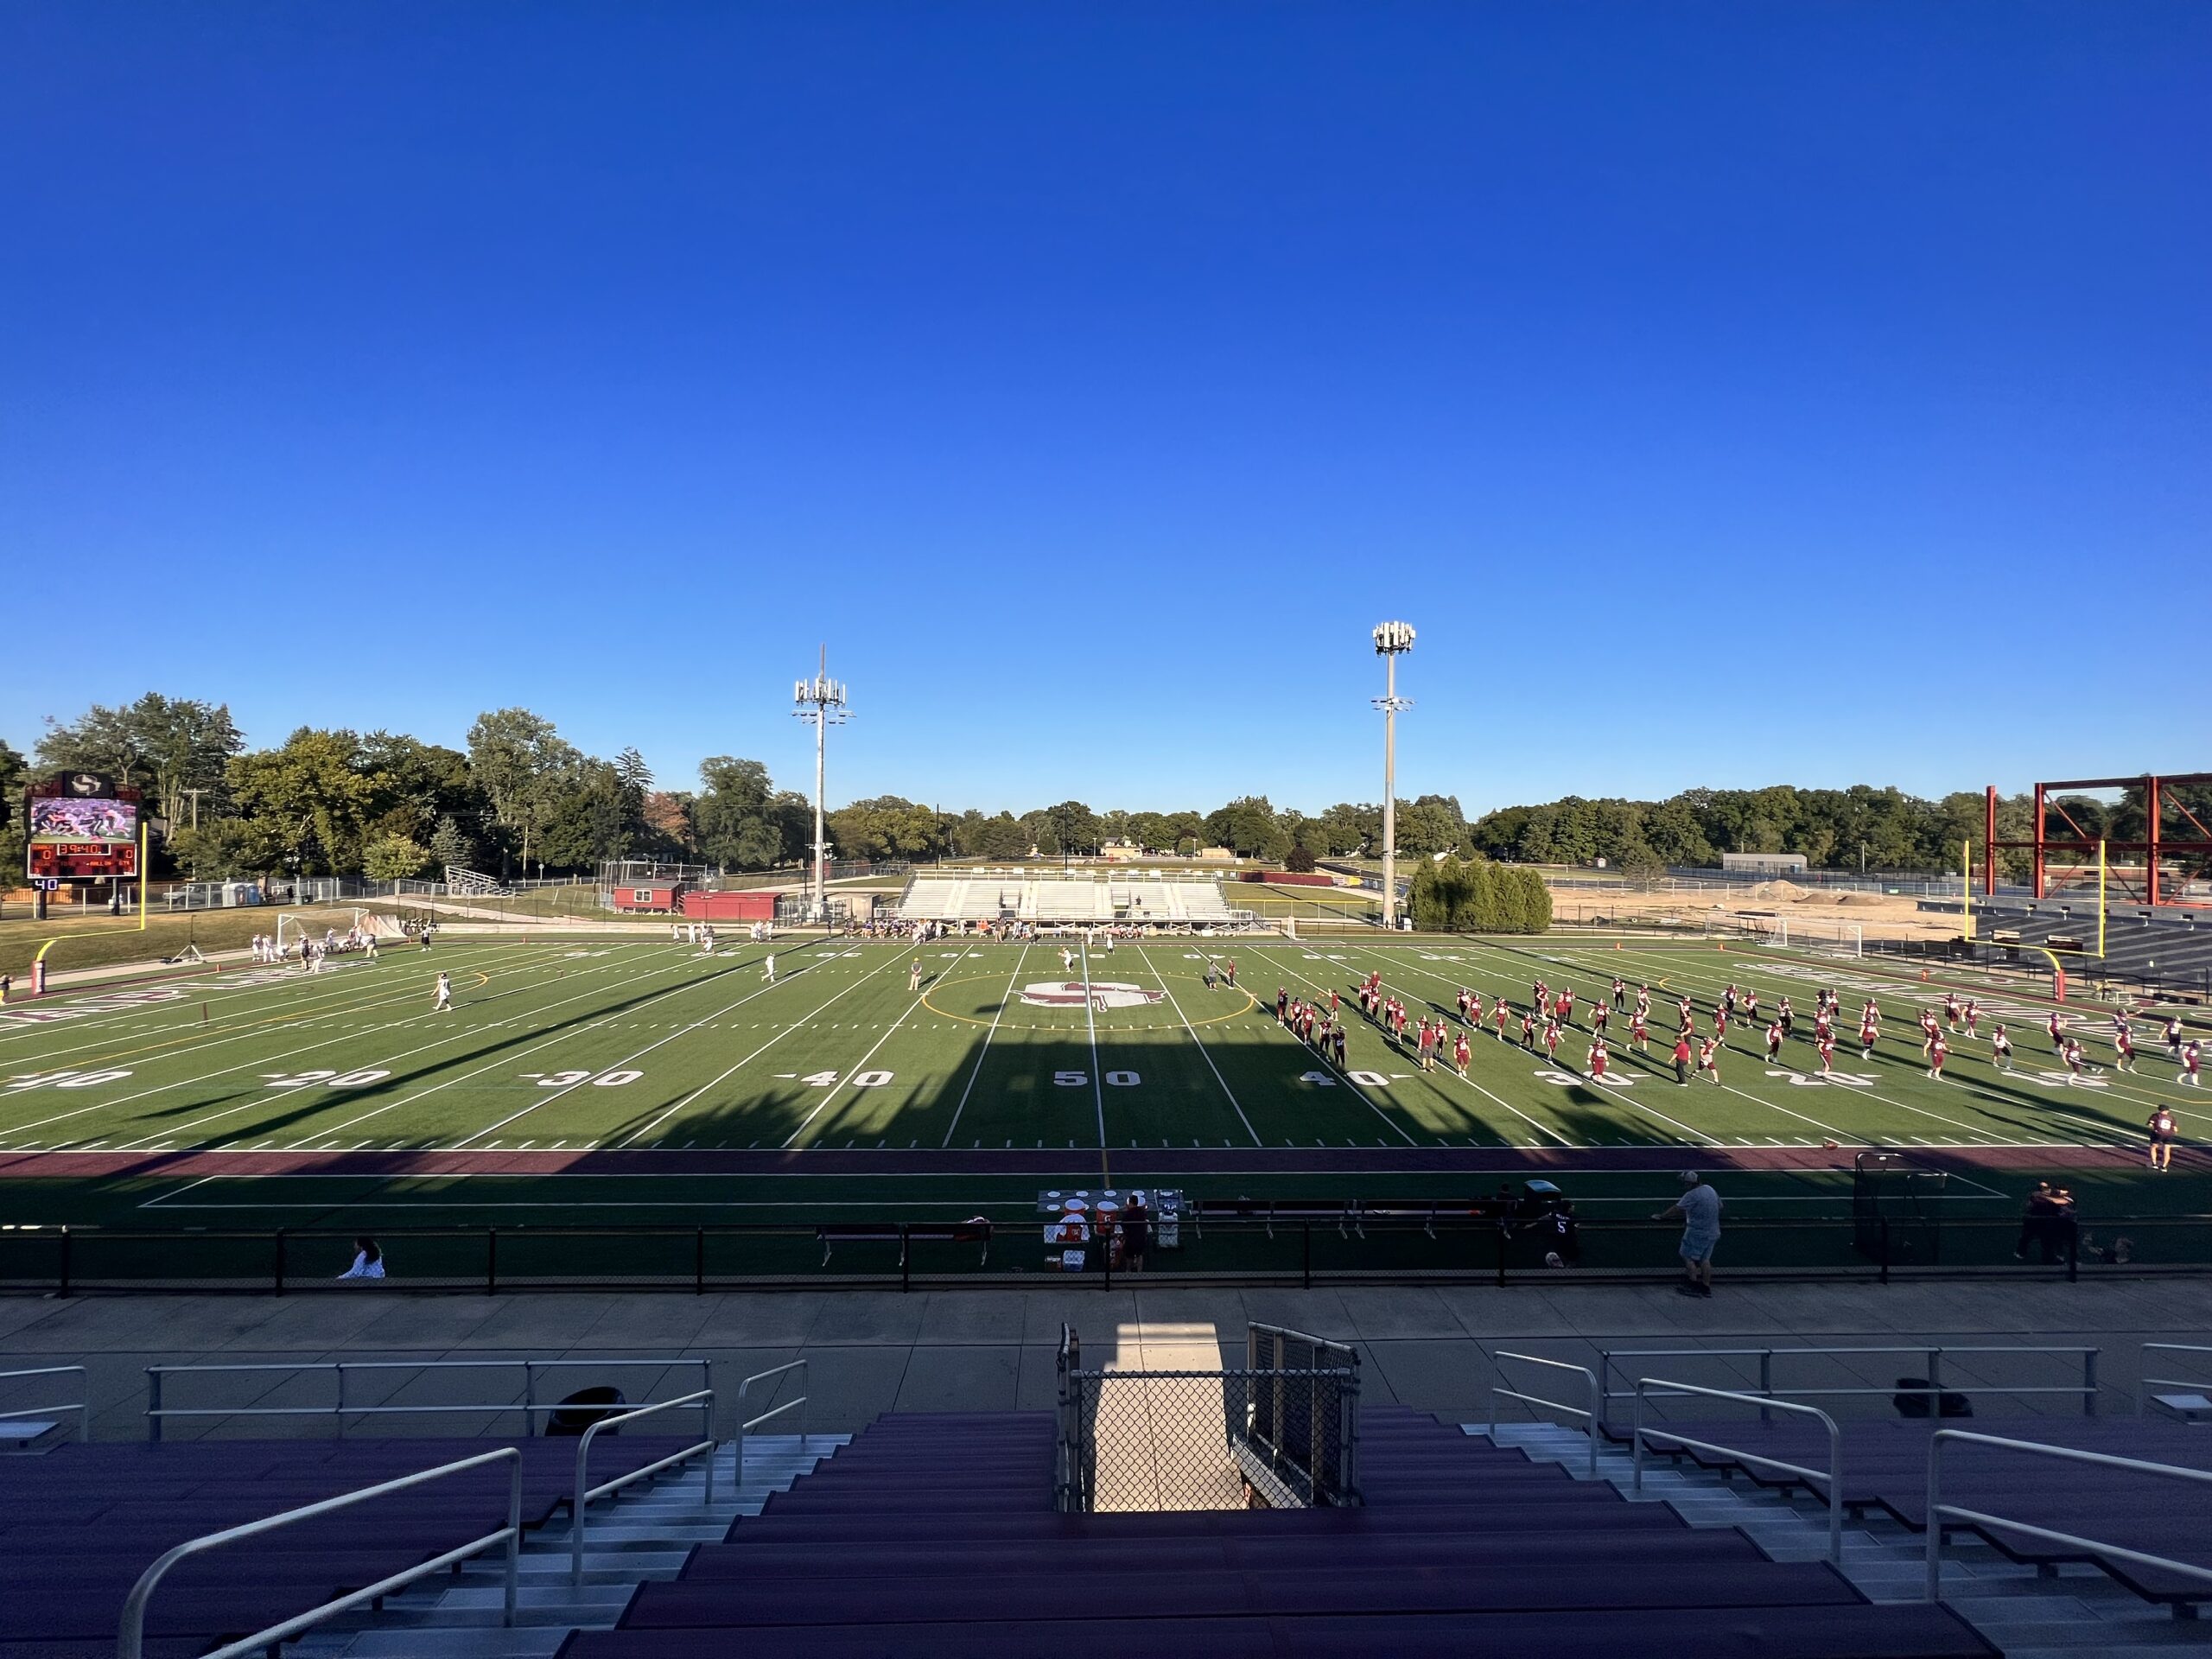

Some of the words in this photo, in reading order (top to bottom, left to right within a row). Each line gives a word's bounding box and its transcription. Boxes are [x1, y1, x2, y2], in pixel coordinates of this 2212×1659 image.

[35, 879, 58, 890] 40
[264, 1070, 391, 1087] 20
[537, 1070, 645, 1087] 30
[800, 1070, 895, 1087] 40
[1052, 1071, 1141, 1087] 50
[1299, 1071, 1390, 1086] 40
[1764, 1071, 1875, 1086] 20
[1558, 1221, 1566, 1233] 5
